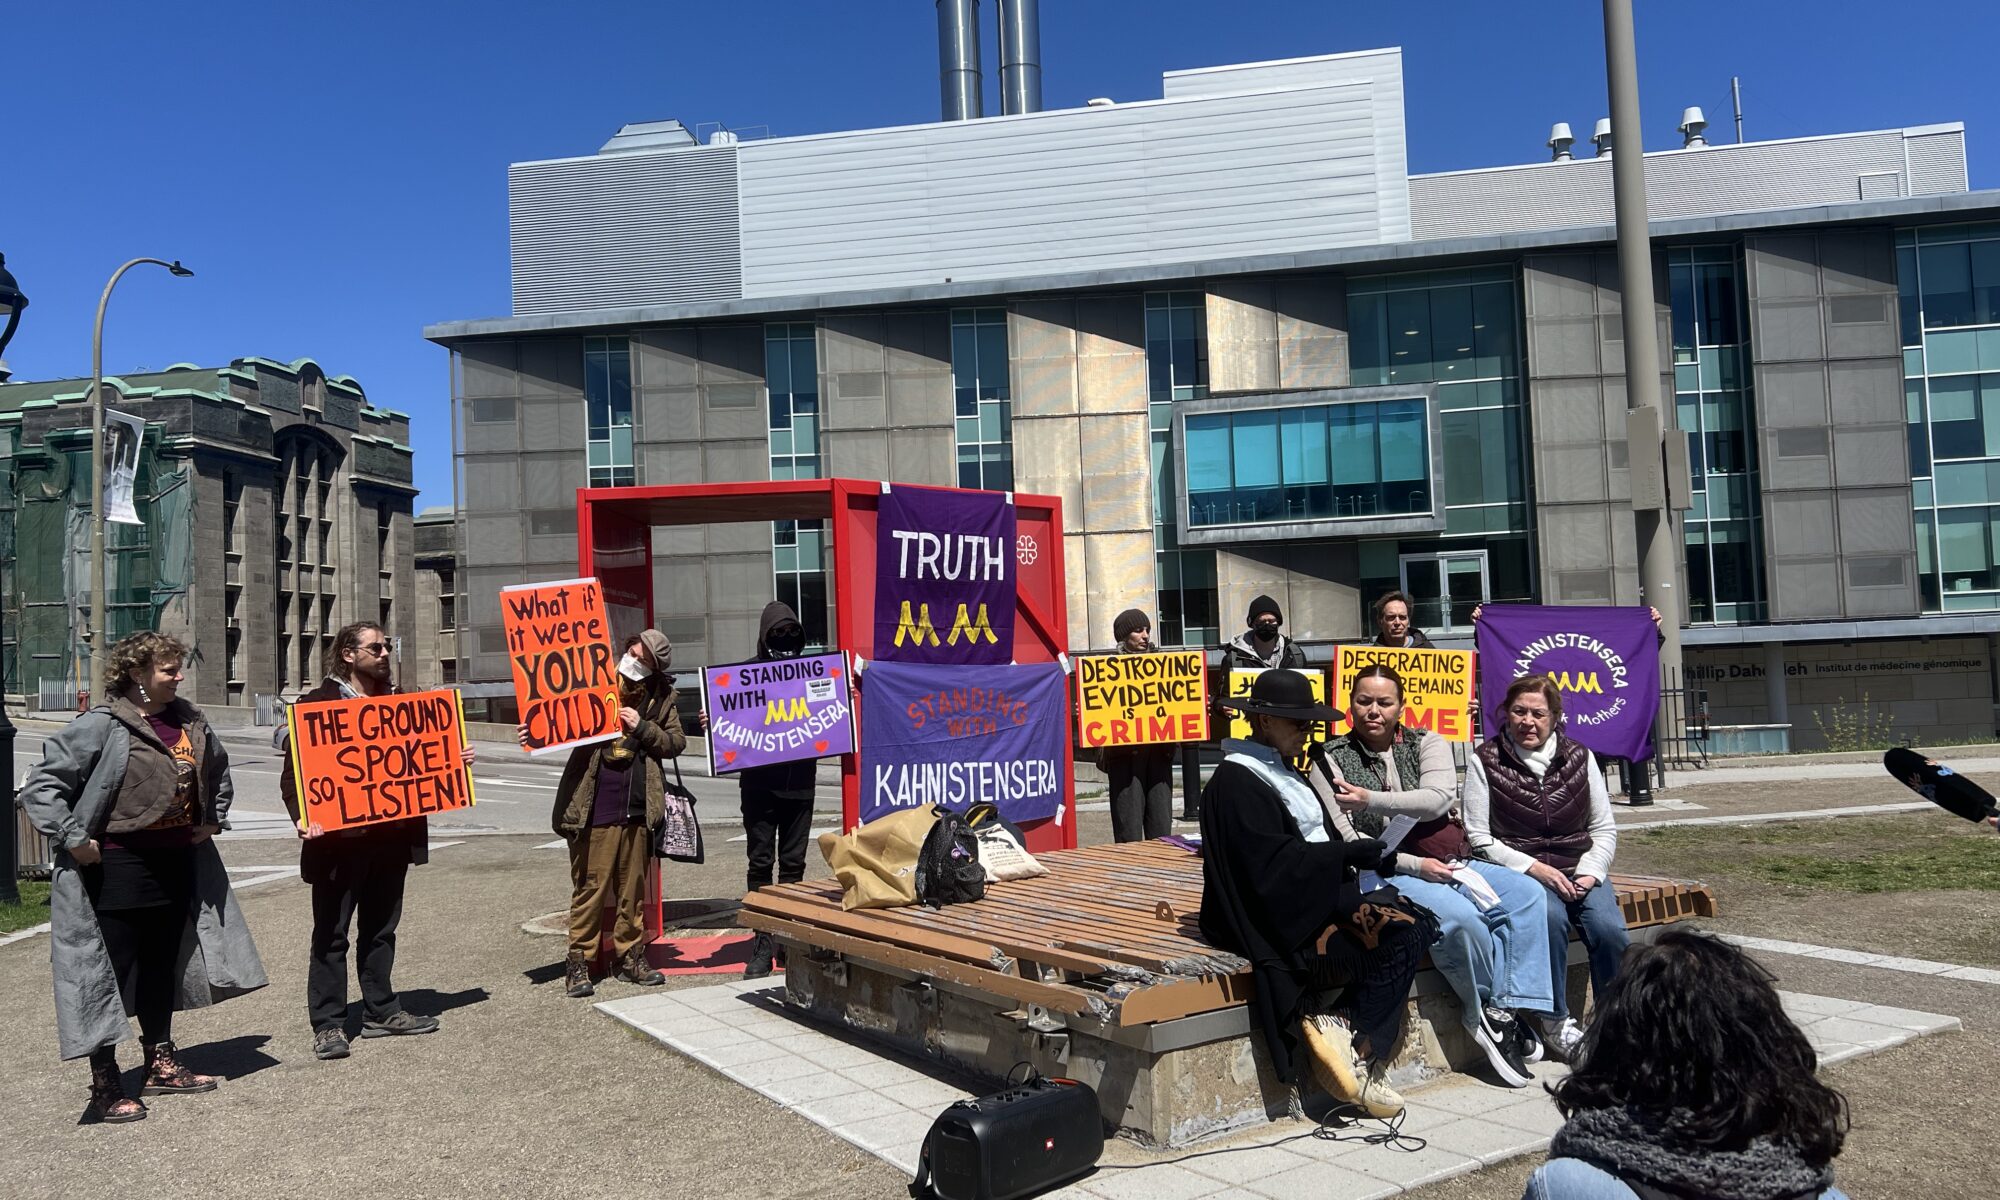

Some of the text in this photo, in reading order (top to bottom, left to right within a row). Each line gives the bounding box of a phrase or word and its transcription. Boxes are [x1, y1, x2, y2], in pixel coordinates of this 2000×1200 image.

[892, 530, 1004, 581] TRUTH
[509, 588, 570, 622] What
[582, 584, 596, 612] if
[509, 618, 603, 652] it were
[515, 642, 616, 701] YOUR
[739, 659, 824, 687] STANDING
[1081, 654, 1202, 684] DESTROYING
[1513, 633, 1629, 688] KAHNISTENSERA
[1682, 663, 1726, 681] hillip
[1816, 664, 1852, 673] Institut
[1855, 662, 1867, 671] de
[1870, 660, 1921, 671] médecine
[1923, 658, 1982, 671] génomique
[719, 689, 767, 712] WITH
[907, 687, 1028, 730] STANDING
[1083, 679, 1202, 711] EVIDENCE
[1156, 705, 1167, 718] a
[1412, 696, 1423, 705] a
[1577, 697, 1626, 725] Mothers
[303, 697, 453, 747] THE GROUND
[525, 691, 620, 749] CHILD?
[712, 699, 849, 752] KAHNISTENSERA
[947, 717, 997, 737] WITH
[1085, 713, 1202, 747] CRIME
[335, 735, 452, 784] SPOKE!
[308, 768, 467, 825] SO LISTEN!
[875, 759, 1057, 807] KAHNISTENSERA
